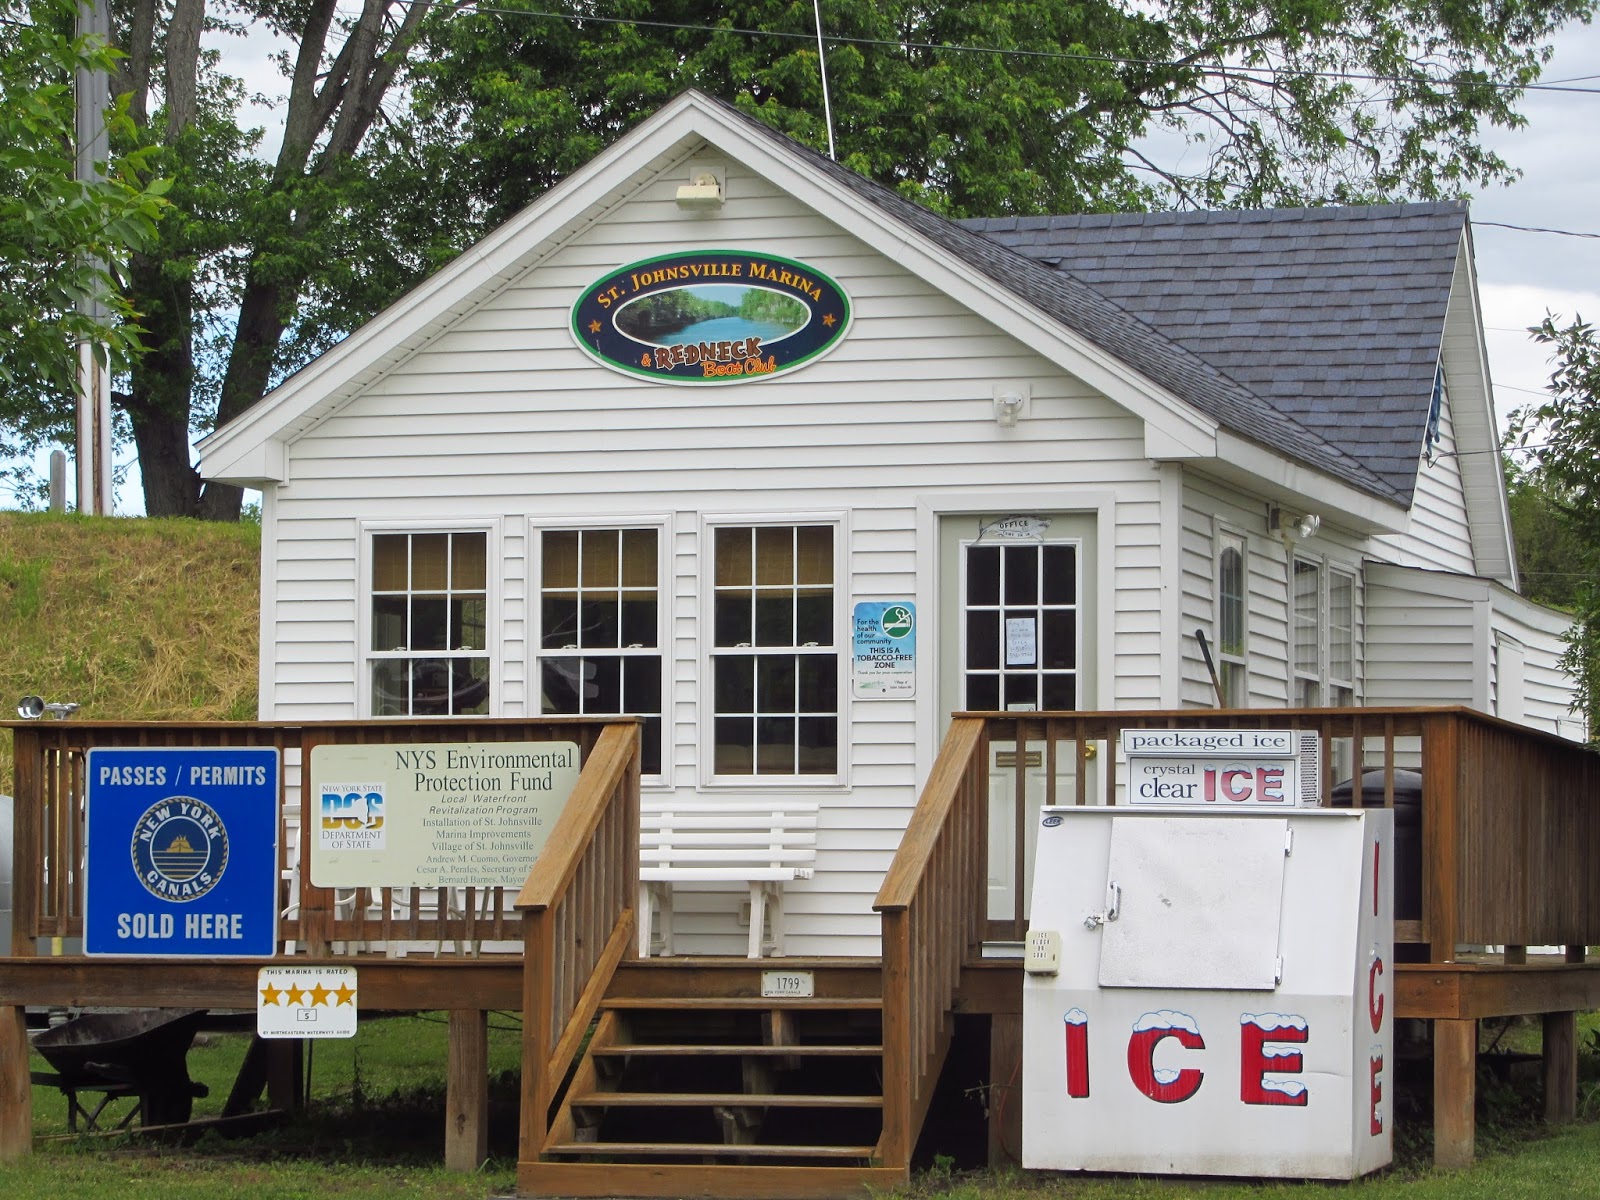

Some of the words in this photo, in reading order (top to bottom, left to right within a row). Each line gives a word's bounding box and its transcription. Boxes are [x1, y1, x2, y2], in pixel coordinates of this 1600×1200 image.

[597, 287, 626, 309] ST.
[631, 263, 742, 292] JOHNSVILLE
[749, 262, 822, 302] MARINA
[641, 353, 651, 367] &
[654, 337, 762, 371] REDNECK
[701, 361, 743, 377] Boat
[745, 356, 776, 375] Club
[1000, 520, 1028, 529] OFFICE
[1132, 733, 1244, 751] packaged
[1253, 734, 1286, 748] ice
[395, 750, 436, 770] NYS
[447, 748, 573, 769] Environmental
[100, 766, 167, 786] PASSES
[174, 765, 182, 787] /
[190, 766, 266, 786] PERMITS
[1143, 764, 1196, 777] crystal
[322, 784, 340, 792] NEW
[341, 784, 361, 792] YORK
[362, 784, 383, 792] STATE
[414, 771, 501, 792] Protection
[510, 771, 553, 791] Fund
[1139, 777, 1198, 799] clear
[1203, 763, 1286, 802] ICE
[441, 795, 467, 803] Local
[473, 794, 527, 803] Waterfront
[322, 792, 384, 830] DOS
[429, 805, 494, 815] Revitalization
[496, 805, 538, 816] Program
[139, 805, 171, 842] NEW
[180, 803, 221, 840] YORK
[423, 818, 471, 827] Installation
[473, 817, 483, 827] of
[484, 817, 496, 826] St.
[498, 817, 543, 827] Johnsville
[322, 830, 382, 840] DEPARTMENT
[436, 830, 467, 839] Marina
[469, 829, 531, 840] Improvements
[346, 840, 371, 849] STATE
[432, 842, 463, 853] Village
[465, 842, 475, 851] of
[476, 841, 487, 851] St.
[490, 841, 534, 851] Johnsville
[426, 855, 455, 863] Andrew
[458, 855, 468, 863] M.
[470, 854, 500, 864] Cuomo,
[502, 854, 538, 863] Governor
[416, 865, 438, 874] Cesar
[440, 866, 449, 874] A.
[450, 865, 480, 875] Perales,
[481, 865, 516, 875] Secretary
[518, 865, 529, 874] of
[146, 870, 212, 896] CANALS
[438, 875, 468, 884] Bernard
[500, 875, 525, 885] Mayor
[117, 913, 174, 939] SOLD
[185, 913, 243, 939] HERE
[777, 977, 800, 990] 1799
[1064, 1006, 1309, 1108] ICE
